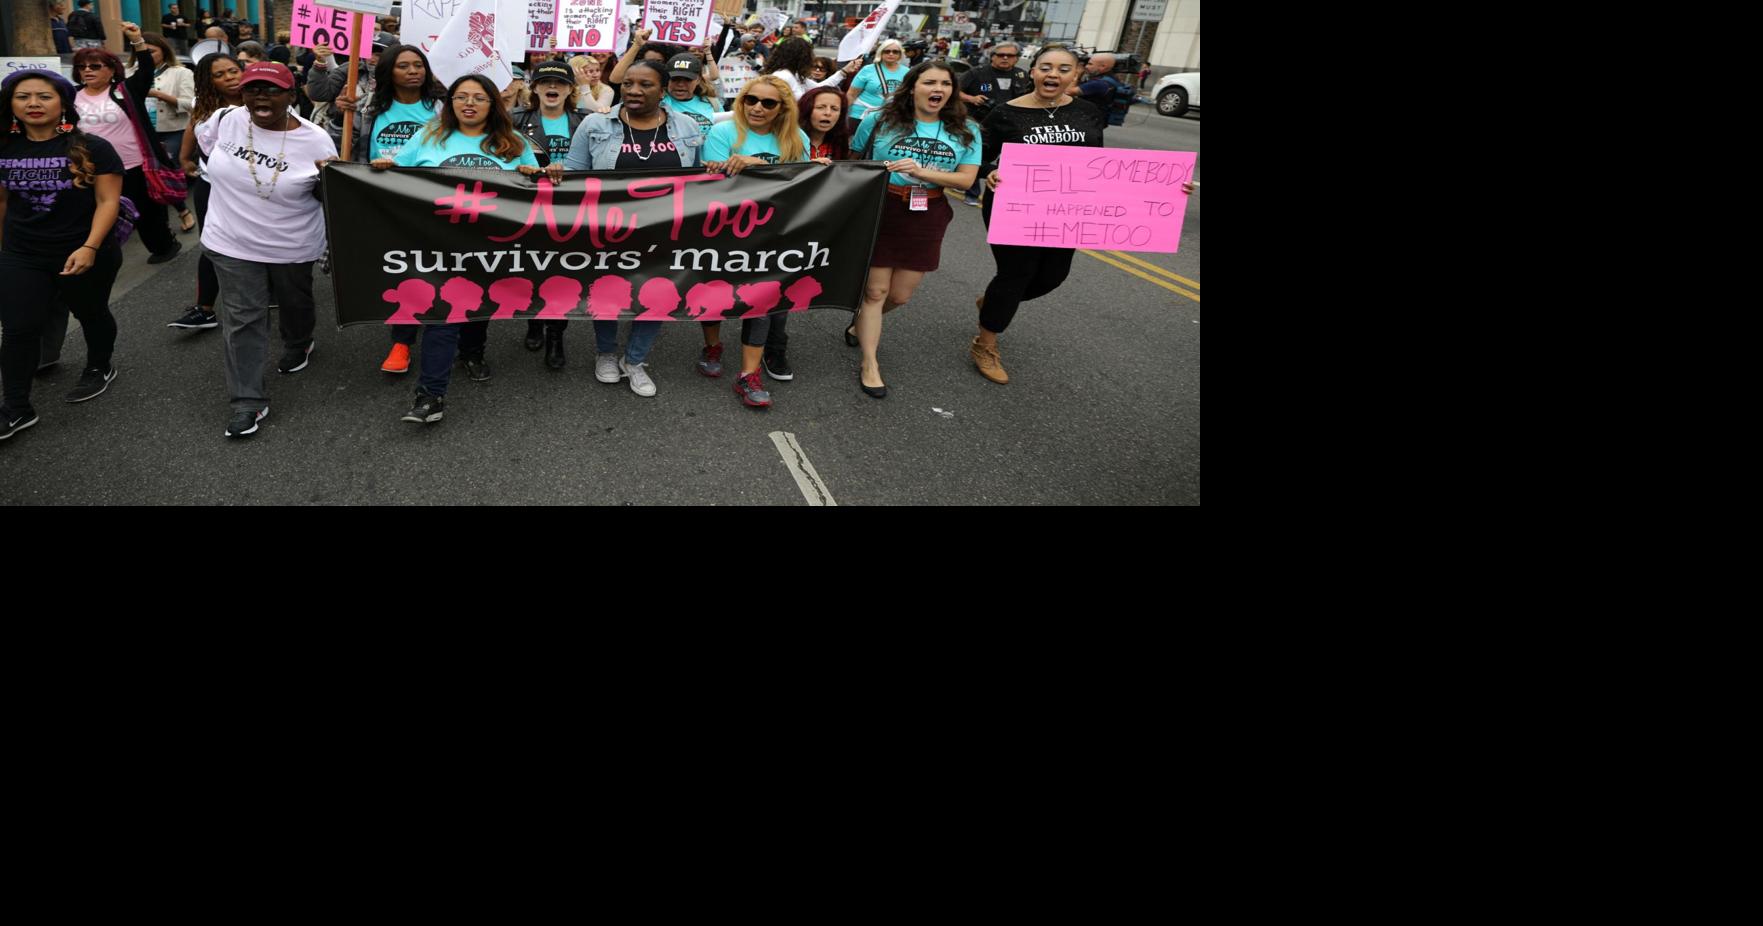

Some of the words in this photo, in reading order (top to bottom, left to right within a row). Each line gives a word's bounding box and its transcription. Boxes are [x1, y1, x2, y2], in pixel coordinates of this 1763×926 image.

[579, 7, 613, 16] attacking
[649, 5, 667, 13] their
[673, 6, 703, 17] RIGHT
[587, 17, 609, 25] RIGHT
[297, 23, 349, 51] TOO
[568, 28, 602, 47] NO
[652, 20, 697, 42] YES
[530, 34, 549, 48] IT
[674, 60, 692, 69] CAT
[1031, 124, 1075, 134] TELL
[1023, 131, 1086, 144] SOMEBODY
[650, 141, 676, 153] too
[0, 156, 71, 168] FEMINIST
[8, 168, 62, 180] FIGHT
[1012, 163, 1097, 195] TELL
[1086, 156, 1194, 186] SOMEBODY
[1006, 202, 1035, 212] IT
[1046, 203, 1127, 218] HAPPENED
[1144, 200, 1175, 217] TO
[1023, 221, 1152, 247] #METOO
[669, 241, 830, 273] march
